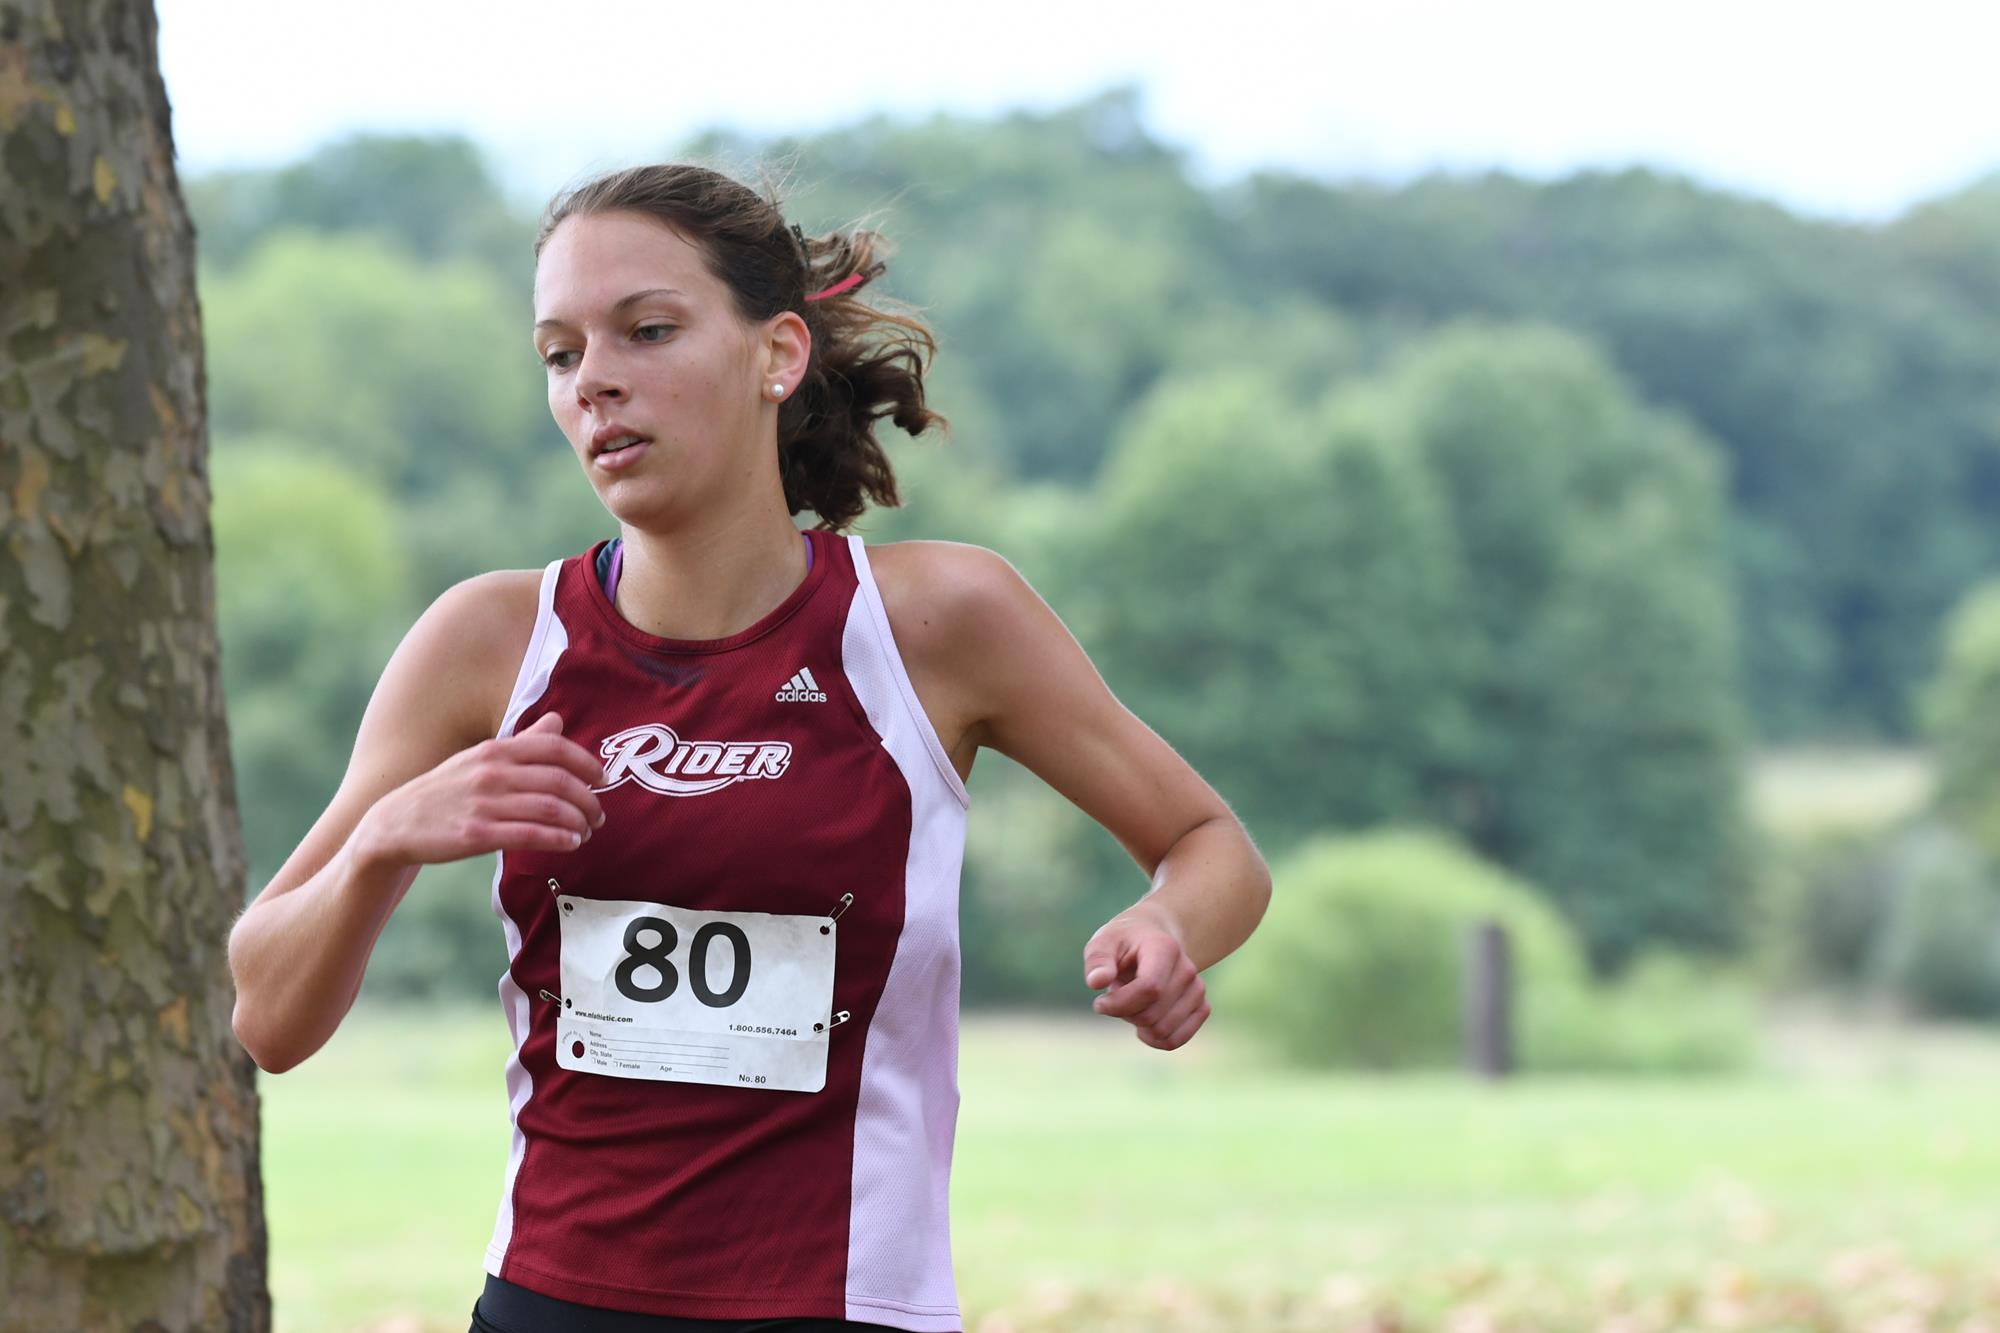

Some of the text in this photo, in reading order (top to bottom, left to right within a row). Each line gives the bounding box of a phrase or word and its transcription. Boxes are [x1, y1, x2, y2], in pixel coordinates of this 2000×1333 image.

[775, 688, 827, 703] adidas
[600, 723, 793, 797] RIDER
[615, 916, 752, 1008] 80
[729, 1024, 798, 1036] 1.800.556.7464
[619, 1062, 641, 1070] Female
[660, 1065, 673, 1073] Age
[738, 1074, 767, 1084] No. 80
